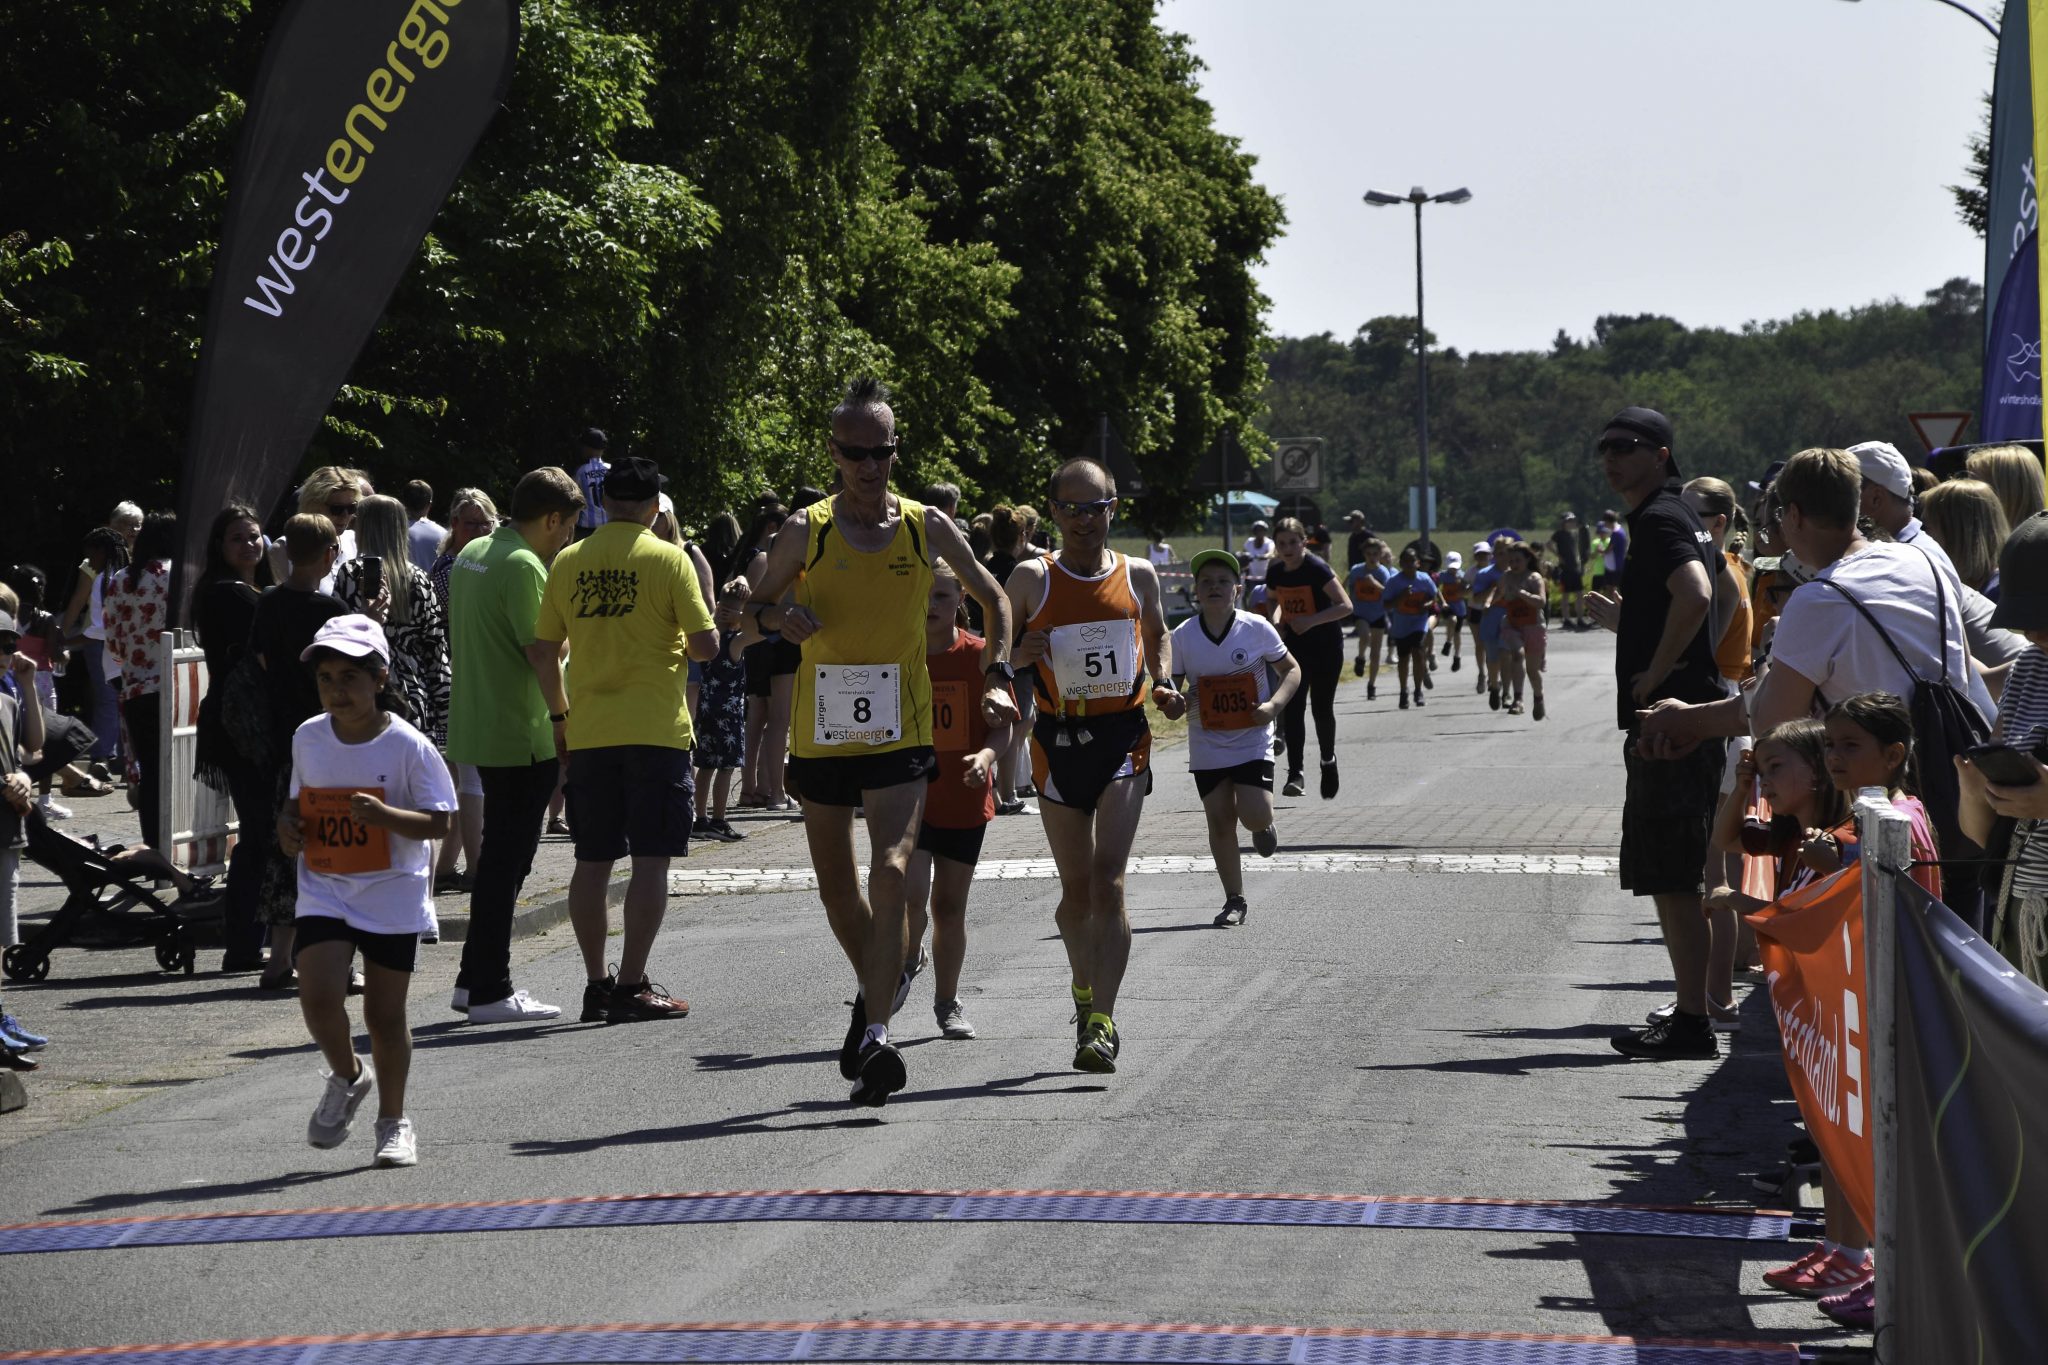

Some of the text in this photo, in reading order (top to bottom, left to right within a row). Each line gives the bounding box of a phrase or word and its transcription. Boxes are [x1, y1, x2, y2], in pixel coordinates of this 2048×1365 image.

[2009, 156, 2038, 260] est
[585, 469, 608, 479] MESS
[1288, 454, 1305, 469] 30
[576, 604, 635, 618] LAIF
[1085, 650, 1118, 677] 51
[817, 695, 826, 728] Jürgen
[853, 697, 871, 723] 8
[1212, 691, 1248, 713] 4035
[319, 816, 368, 848] 4203
[1767, 970, 1841, 1126] tschland.
